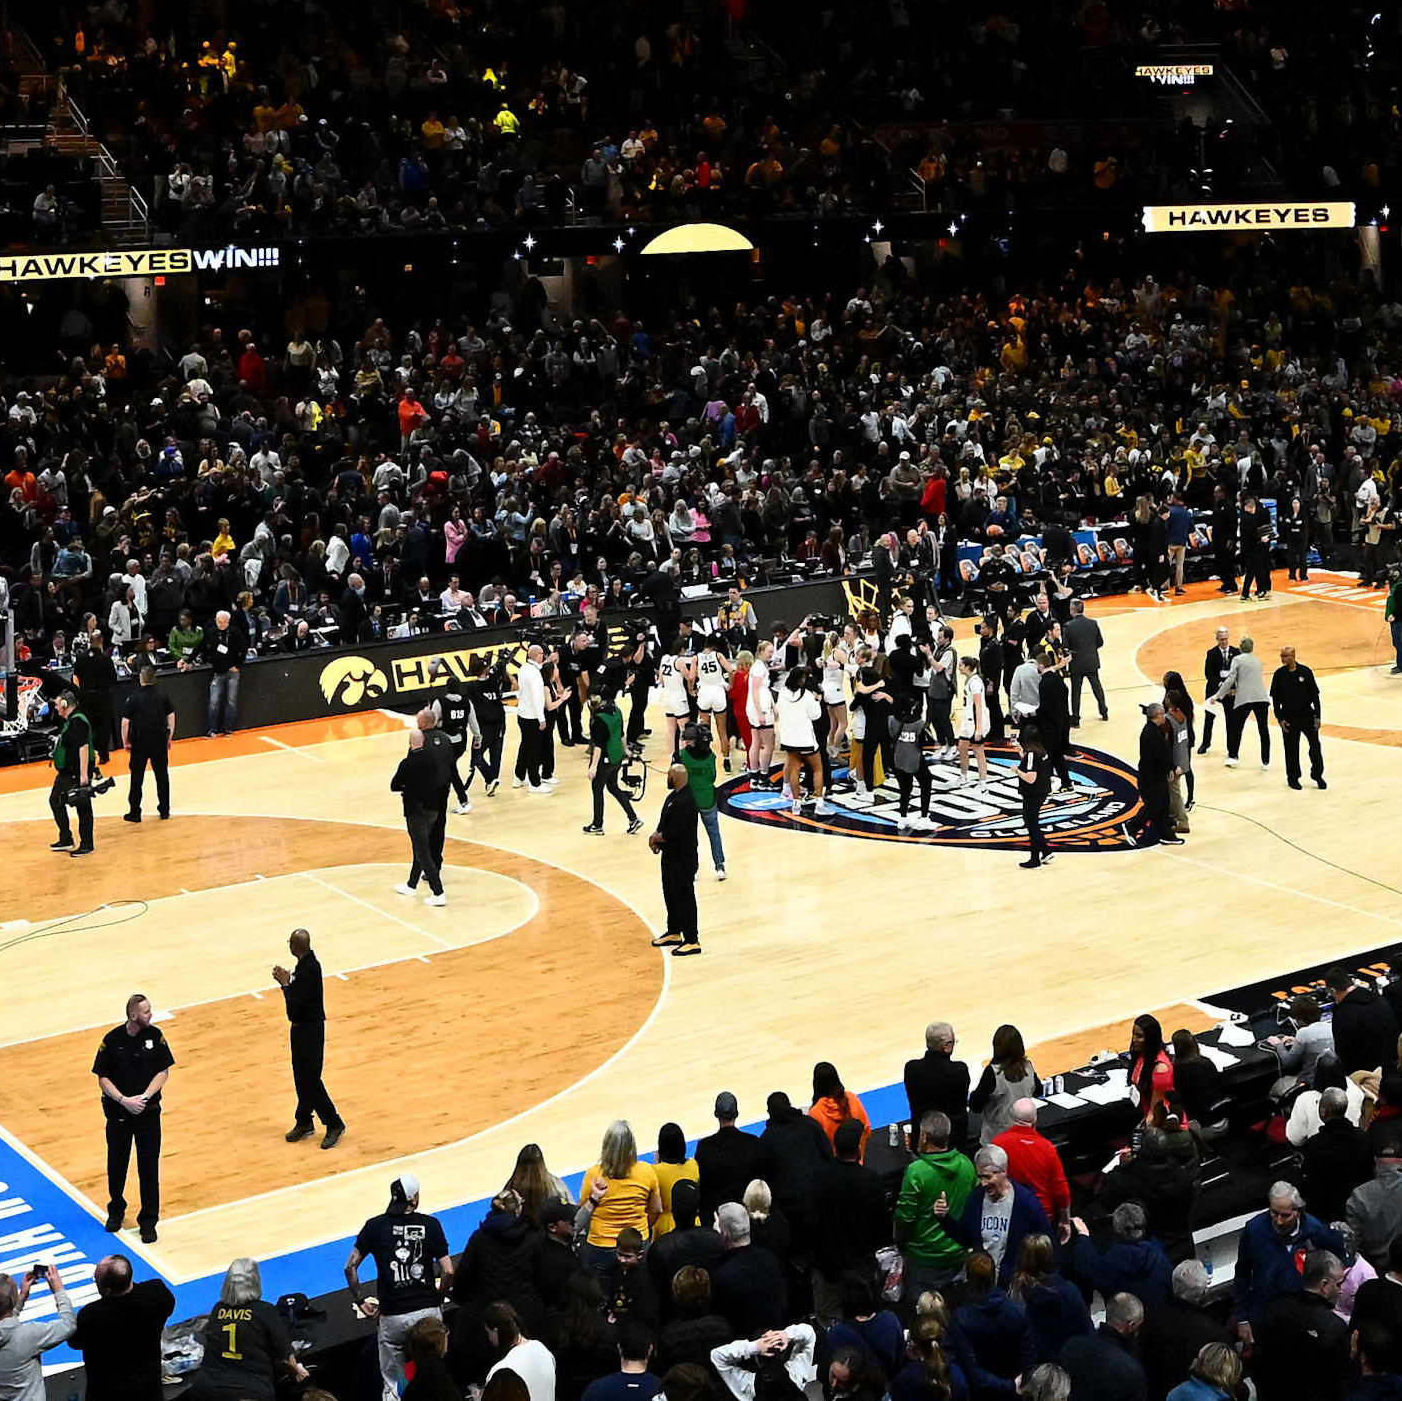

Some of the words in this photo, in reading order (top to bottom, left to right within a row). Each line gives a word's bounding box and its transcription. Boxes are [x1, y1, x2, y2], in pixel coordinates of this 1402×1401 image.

[1169, 205, 1329, 226] HAWKEYES
[194, 246, 279, 271] WIN!!!
[662, 663, 672, 676] 22
[701, 661, 717, 674] 45
[981, 1216, 1008, 1233] UCON
[218, 1307, 252, 1322] DAVIS
[221, 1322, 244, 1360] 1
